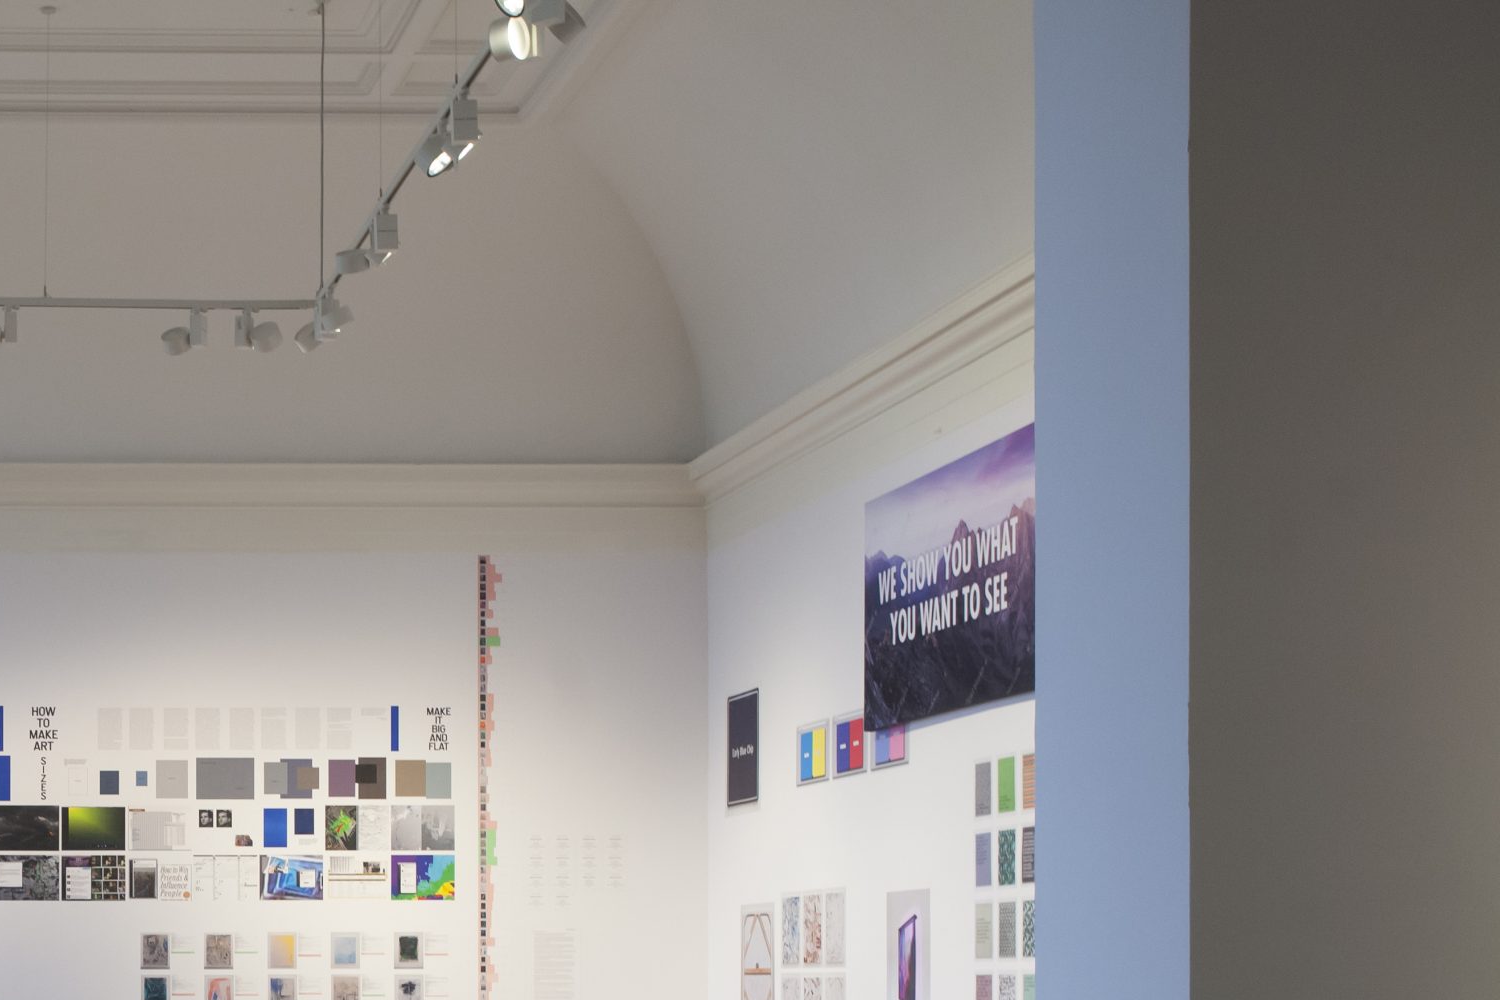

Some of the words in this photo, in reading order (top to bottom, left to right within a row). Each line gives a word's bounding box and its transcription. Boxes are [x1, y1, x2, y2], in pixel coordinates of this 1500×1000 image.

[878, 566, 896, 605] WE
[900, 549, 939, 597] SHOW
[943, 535, 971, 580] YOU
[976, 516, 1018, 568] WHAT
[890, 605, 916, 646] YOU
[920, 589, 958, 636] WANT
[962, 582, 980, 622] TO
[985, 572, 1008, 615] SEE
[31, 706, 56, 716] HOW
[426, 707, 451, 716] MAKE
[37, 717, 50, 728] TO
[435, 716, 442, 724] IT
[29, 729, 58, 739] MAKE
[431, 725, 446, 733] BIG
[430, 733, 448, 742] AND
[33, 741, 54, 751] ART
[428, 742, 449, 751] FLAT
